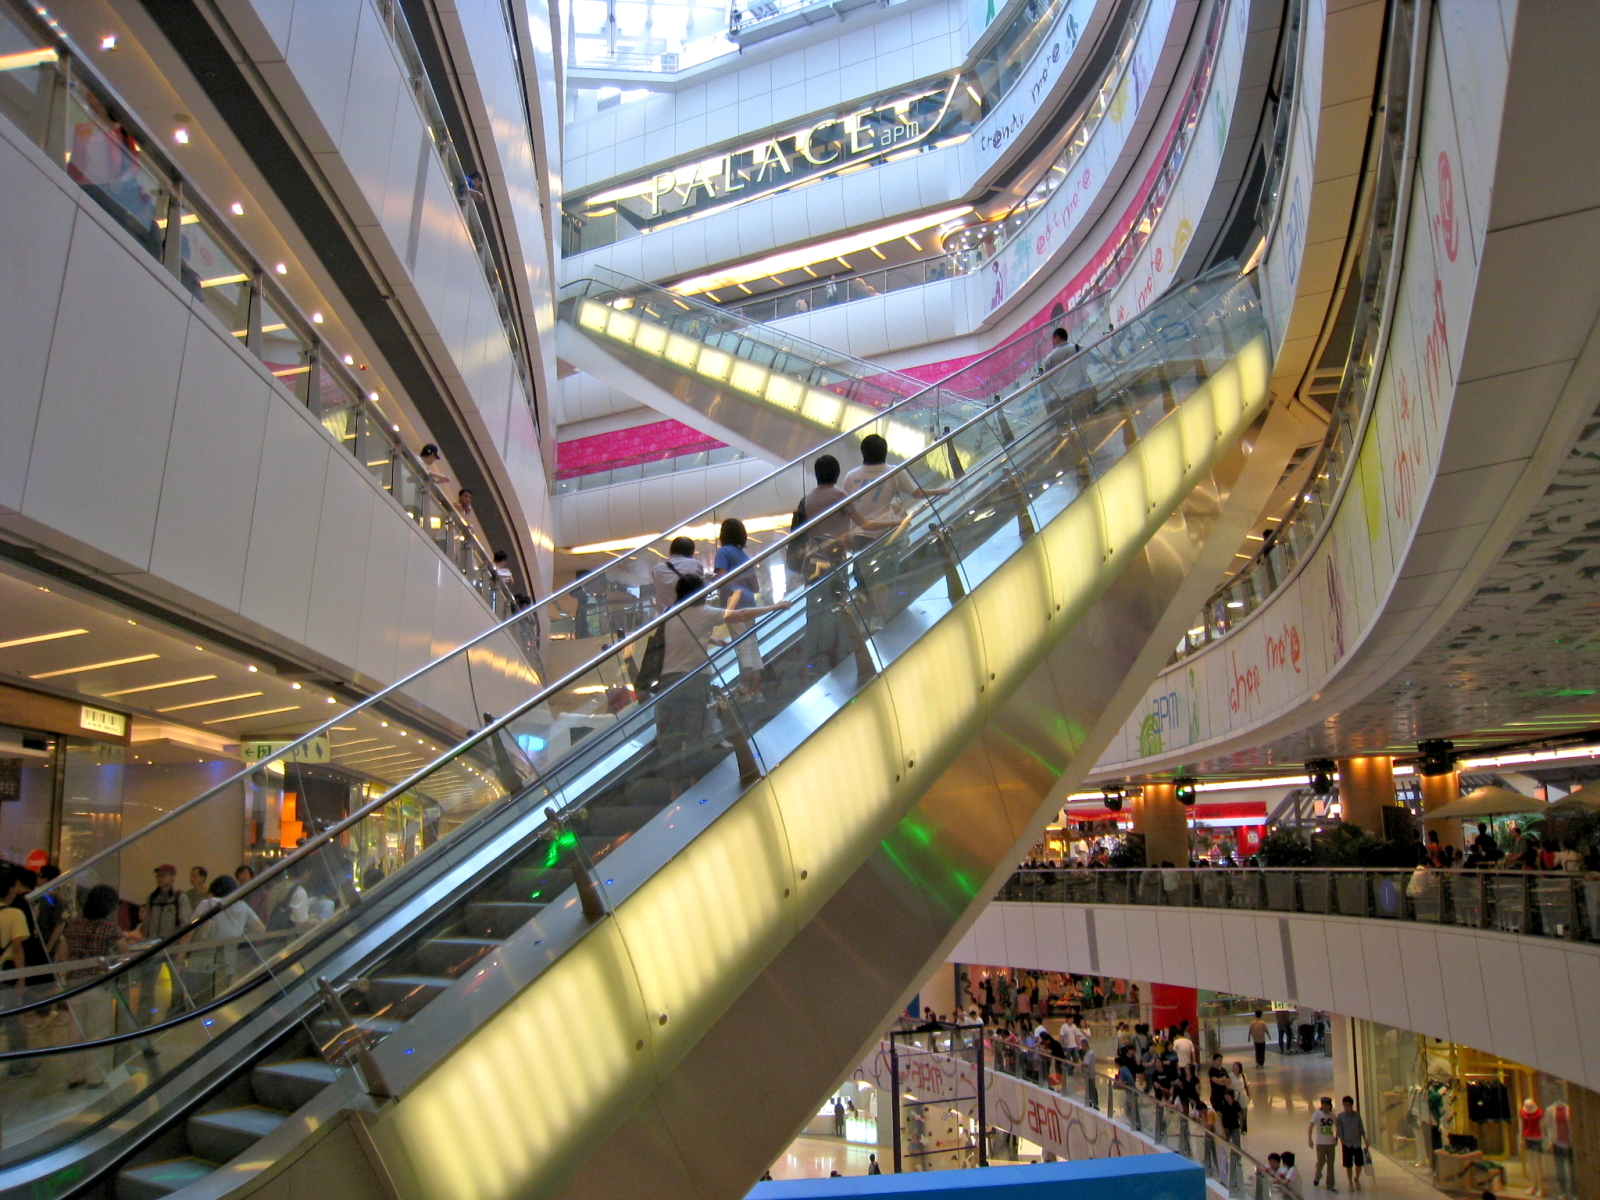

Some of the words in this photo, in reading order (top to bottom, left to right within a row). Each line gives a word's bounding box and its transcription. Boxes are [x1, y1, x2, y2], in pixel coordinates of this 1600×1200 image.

[880, 121, 919, 146] apm
[650, 108, 876, 217] PALACE
[1027, 1099, 1062, 1145] apm
